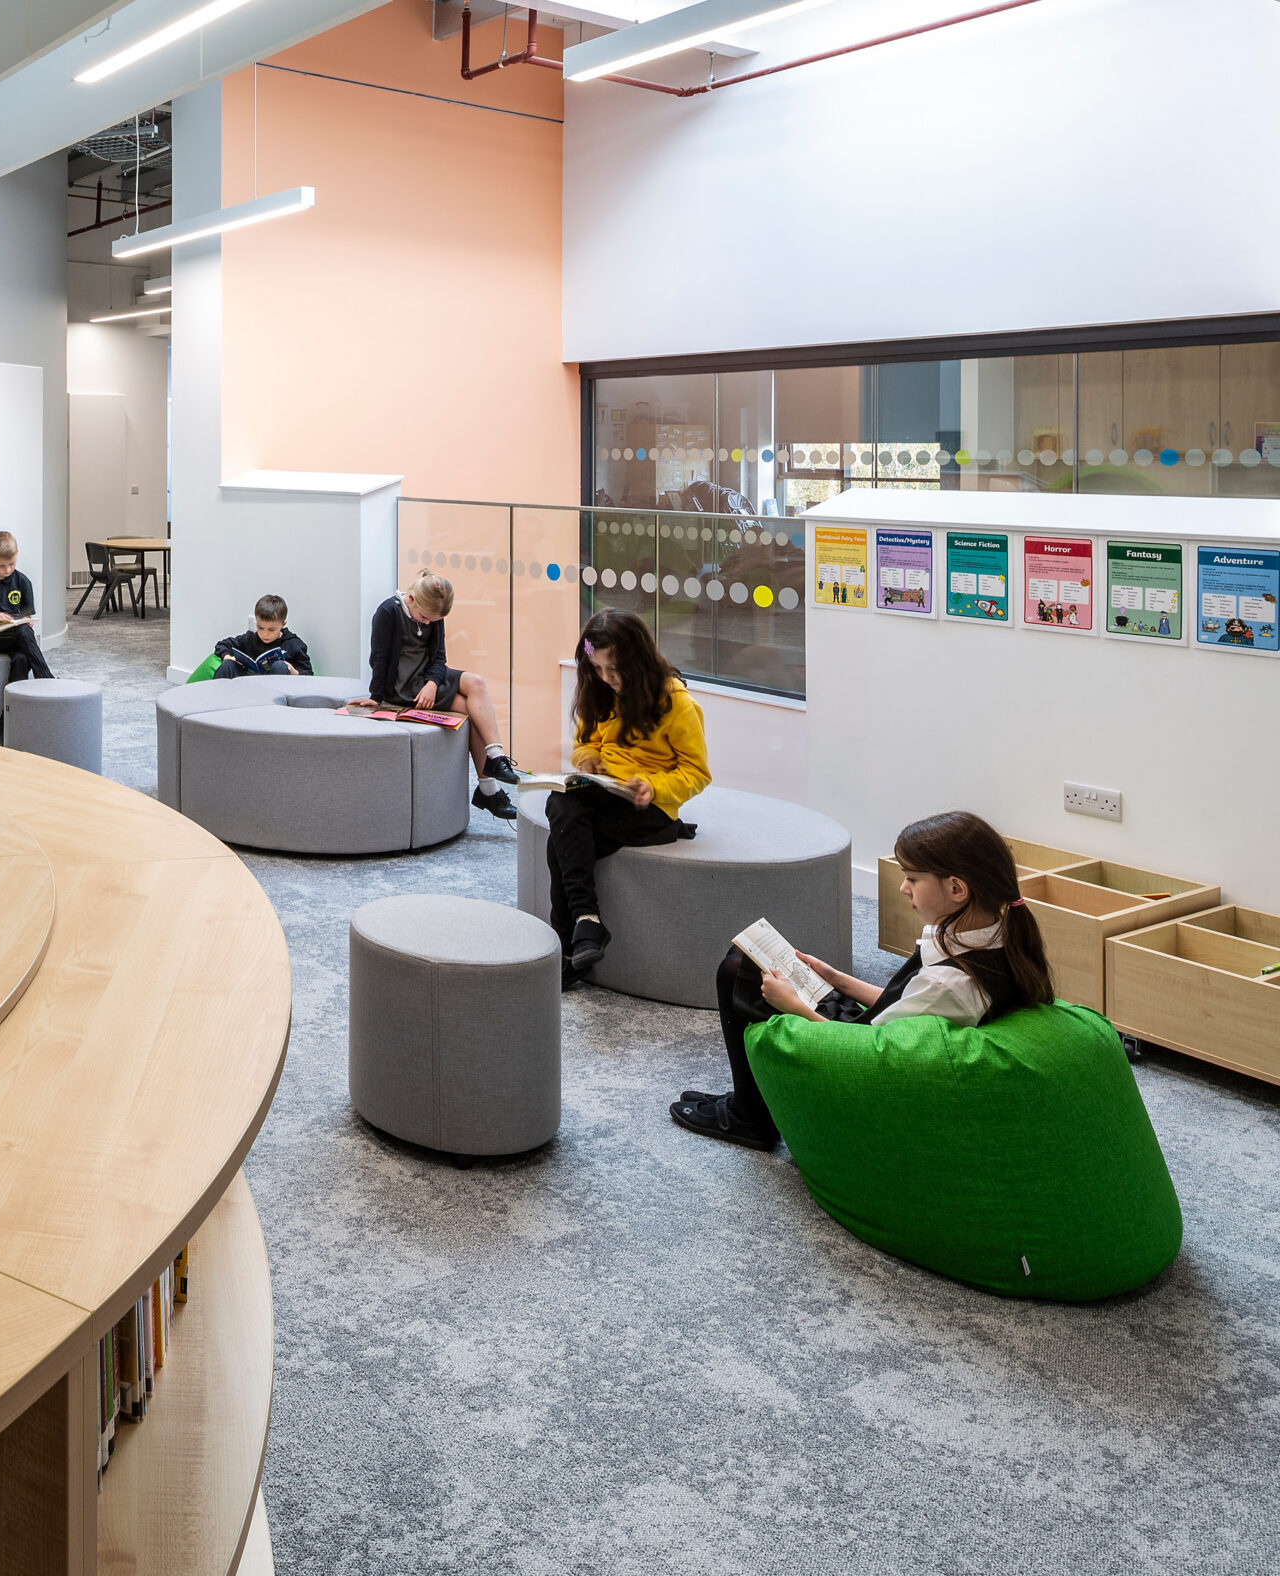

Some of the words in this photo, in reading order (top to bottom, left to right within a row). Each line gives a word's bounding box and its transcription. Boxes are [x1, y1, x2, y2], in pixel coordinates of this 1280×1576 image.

[841, 535, 854, 543] Fairy
[879, 536, 930, 546] Detective/Mystery
[954, 539, 977, 548] Science
[978, 541, 1000, 549] Fiction
[1044, 545, 1072, 553] Horror
[1126, 549, 1162, 561] Fantasy
[1213, 555, 1265, 566] Adventure
